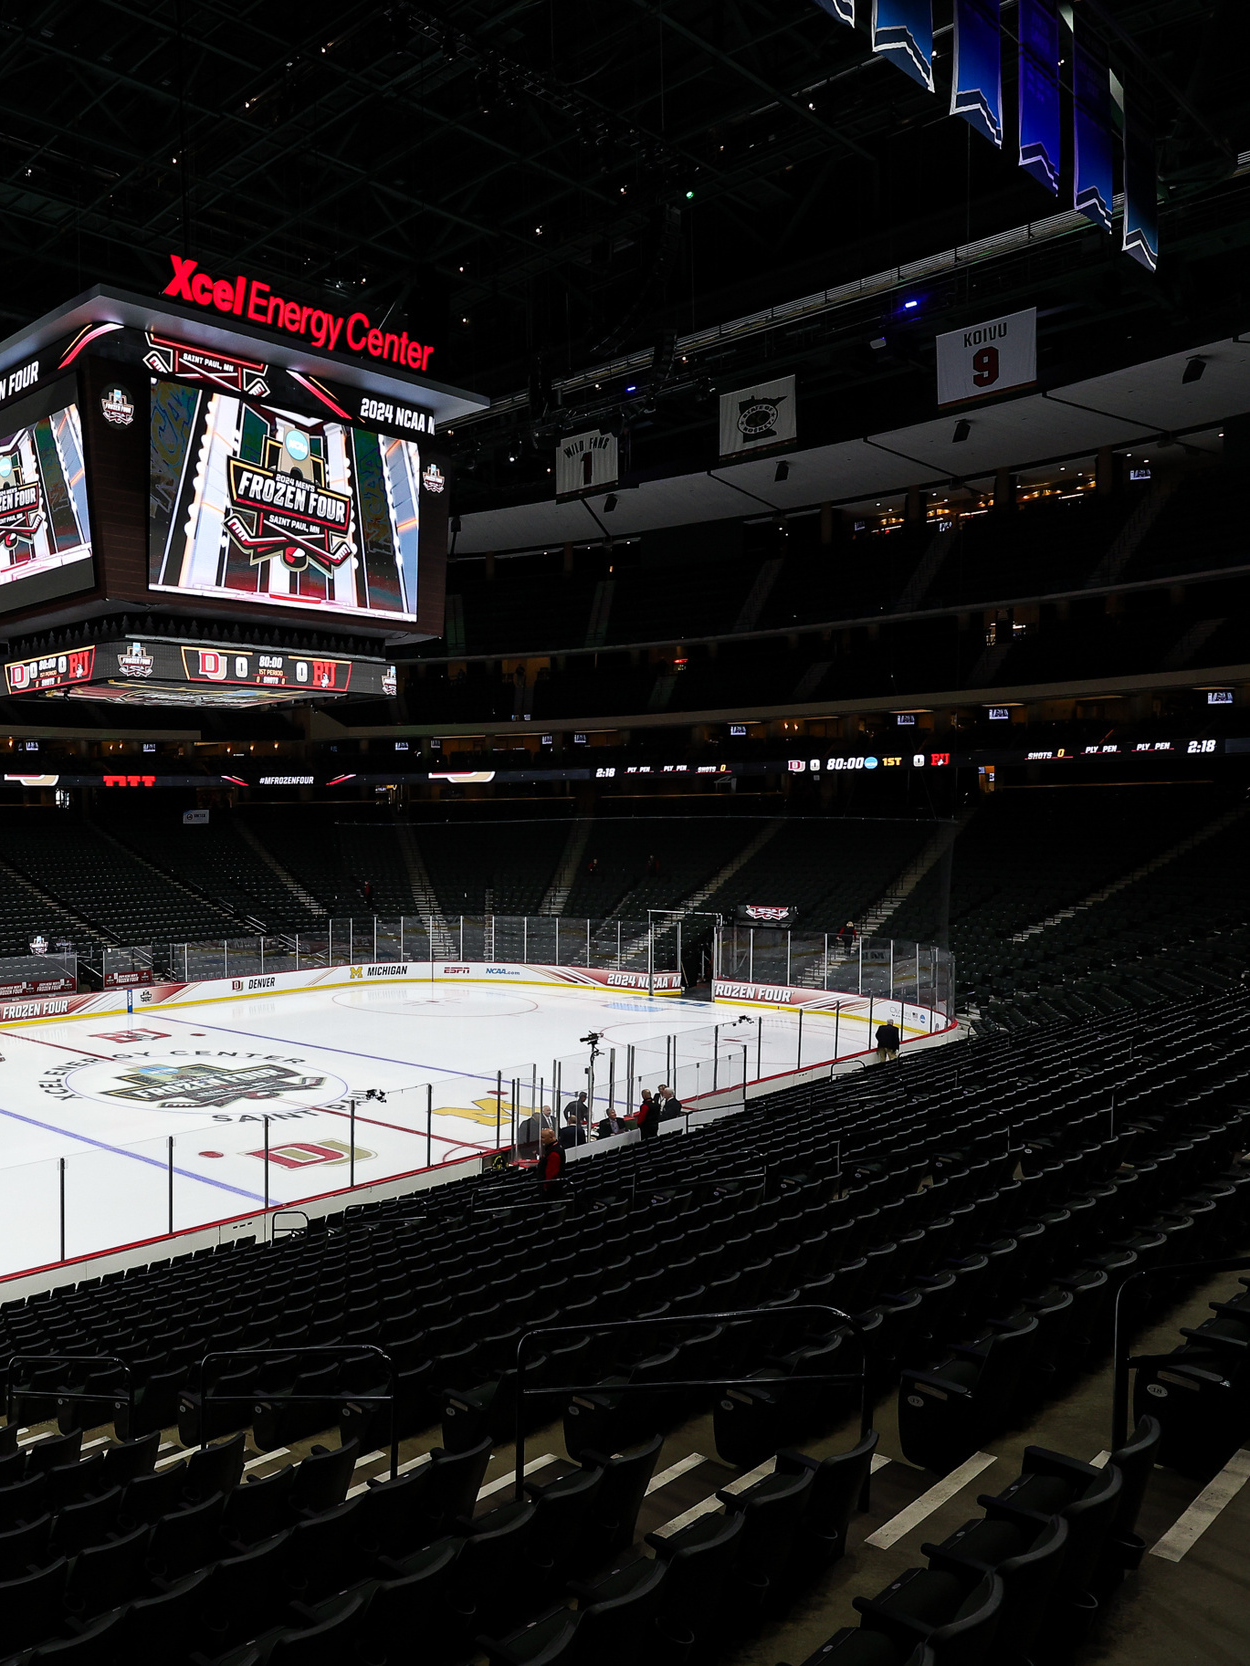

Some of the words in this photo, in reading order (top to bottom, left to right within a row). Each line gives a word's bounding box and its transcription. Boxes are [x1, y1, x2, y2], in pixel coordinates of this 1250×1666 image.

[162, 254, 247, 316] Xcel
[248, 279, 343, 351] Energy
[346, 312, 434, 371] Center
[963, 322, 1007, 348] KOIVU
[183, 352, 204, 365] SAINT
[204, 358, 222, 370] PAUL,
[223, 363, 234, 372] MN
[972, 346, 1000, 388] 9
[8, 360, 39, 396] FOUR
[360, 400, 393, 422] 2024
[395, 406, 426, 430] NCAA
[563, 440, 584, 459] WILD
[590, 436, 610, 450] FANS
[580, 451, 593, 485] 1
[275, 473, 294, 486] 2024
[295, 480, 315, 493] MEN'S
[14, 487, 37, 509] FOUR
[237, 470, 307, 512] FROZEN
[308, 492, 346, 523] FOUR
[269, 514, 291, 527] SAINT
[291, 520, 309, 533] PAUL,
[309, 525, 321, 534] MN
[30, 661, 38, 679] 0
[58, 655, 67, 673] 0
[68, 650, 90, 678] BU
[235, 656, 248, 678] 0
[258, 655, 283, 669] 80:00
[266, 669, 284, 677] PERIOD
[296, 661, 308, 683] 0
[312, 661, 336, 687] BU
[1027, 752, 1052, 760] SHOTS
[1057, 748, 1065, 758] 0
[1085, 746, 1099, 754] PLY
[1102, 745, 1117, 753] PEN
[1136, 743, 1150, 751] PLY
[1154, 742, 1171, 750] PEN
[1187, 739, 1216, 753] 2:18
[720, 764, 726, 772] 0
[826, 757, 865, 770] 80:00
[882, 757, 902, 766] 1ST
[930, 753, 950, 766] BU
[259, 776, 314, 785] #MFROZENFOUR
[595, 767, 616, 778] 2:18
[350, 966, 363, 979] M
[367, 965, 408, 977] MICHIGAN
[443, 966, 470, 974] ESPN
[485, 967, 520, 976] NCAA.com
[248, 977, 276, 990] DENVER
[606, 973, 636, 986] 2024
[714, 983, 756, 999] ROZEN
[757, 988, 791, 1003] FOUR
[2, 1003, 41, 1020] FROZEN
[42, 1001, 69, 1015] FOUR
[169, 1049, 306, 1065] CENTER
[132, 1078, 221, 1098] FROZEN
[221, 1068, 285, 1083] FOUR
[212, 1108, 321, 1123] SAINT
